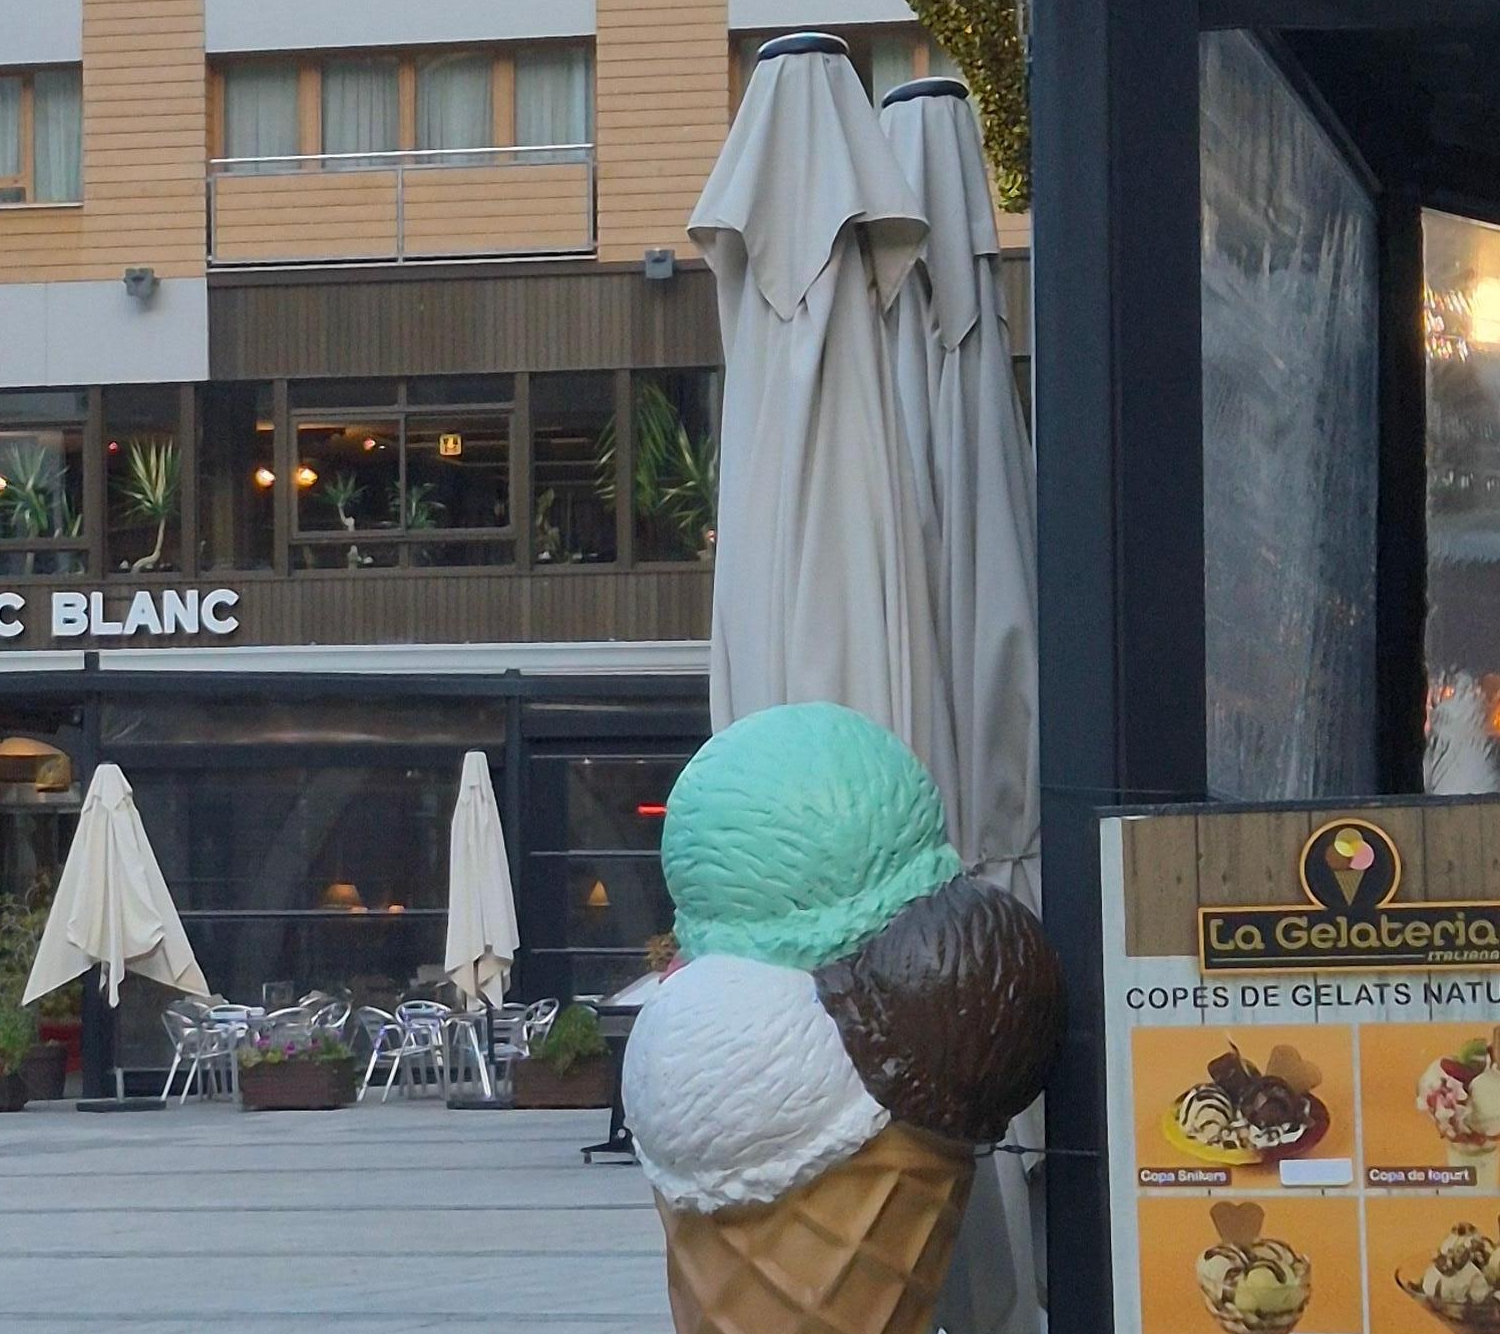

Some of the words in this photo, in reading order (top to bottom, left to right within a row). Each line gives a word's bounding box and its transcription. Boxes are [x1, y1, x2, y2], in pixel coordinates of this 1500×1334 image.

[52, 589, 240, 636] BLANC
[1209, 918, 1266, 950] La
[1275, 912, 1500, 950] Gelateria
[1126, 986, 1230, 1009] COPES
[1241, 985, 1281, 1008] DE
[1291, 982, 1412, 1007] GELATS
[1140, 1169, 1176, 1183] Copa
[1369, 1168, 1406, 1183] Copa
